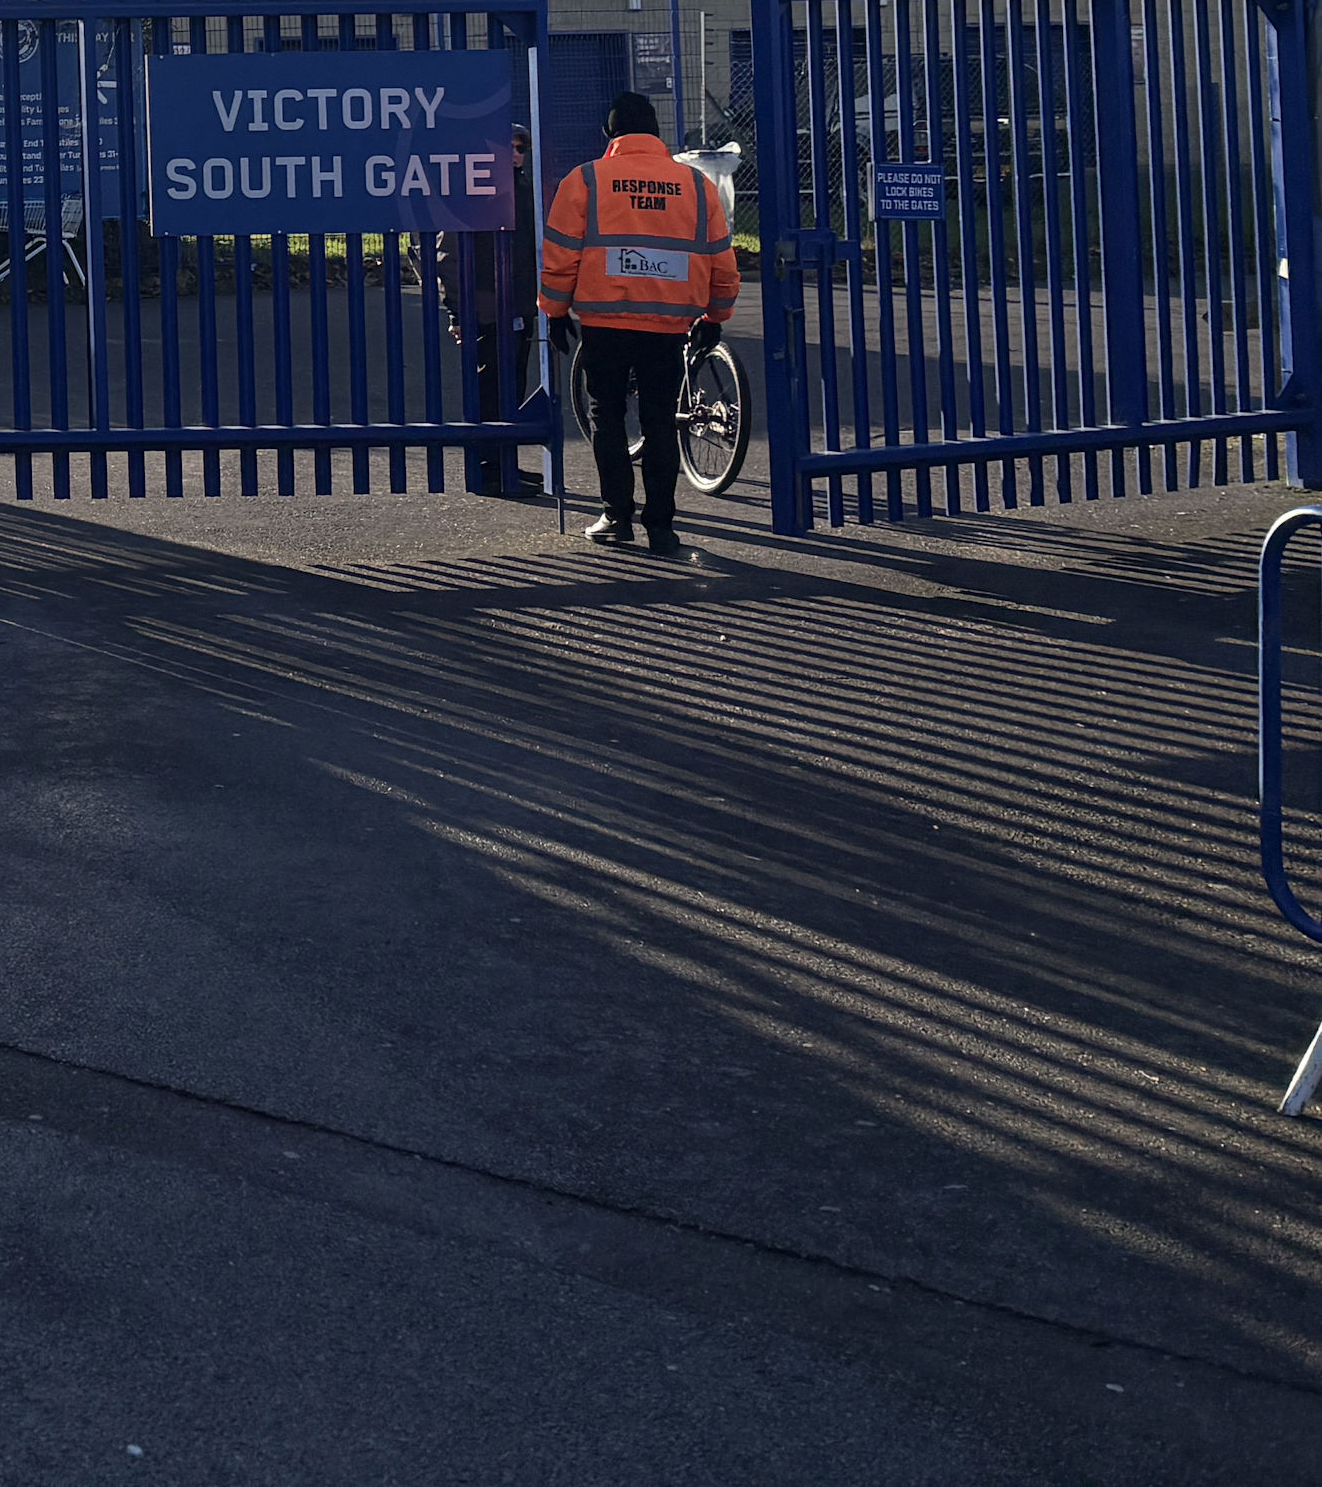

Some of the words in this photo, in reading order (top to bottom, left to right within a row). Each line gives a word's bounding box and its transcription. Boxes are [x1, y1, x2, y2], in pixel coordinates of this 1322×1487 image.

[212, 86, 445, 132] VICTORY
[165, 154, 343, 200] SOUTH
[365, 153, 497, 197] GATE
[877, 172, 910, 184] PLEASE
[911, 173, 923, 184] DO
[924, 173, 941, 184] NOT
[613, 179, 682, 195] RESPONSE
[885, 186, 908, 197] LOCK
[909, 186, 934, 197] BIKES
[629, 195, 666, 210] TEAM
[880, 199, 892, 210] TO
[893, 199, 910, 210] THE
[911, 200, 939, 211] GATES
